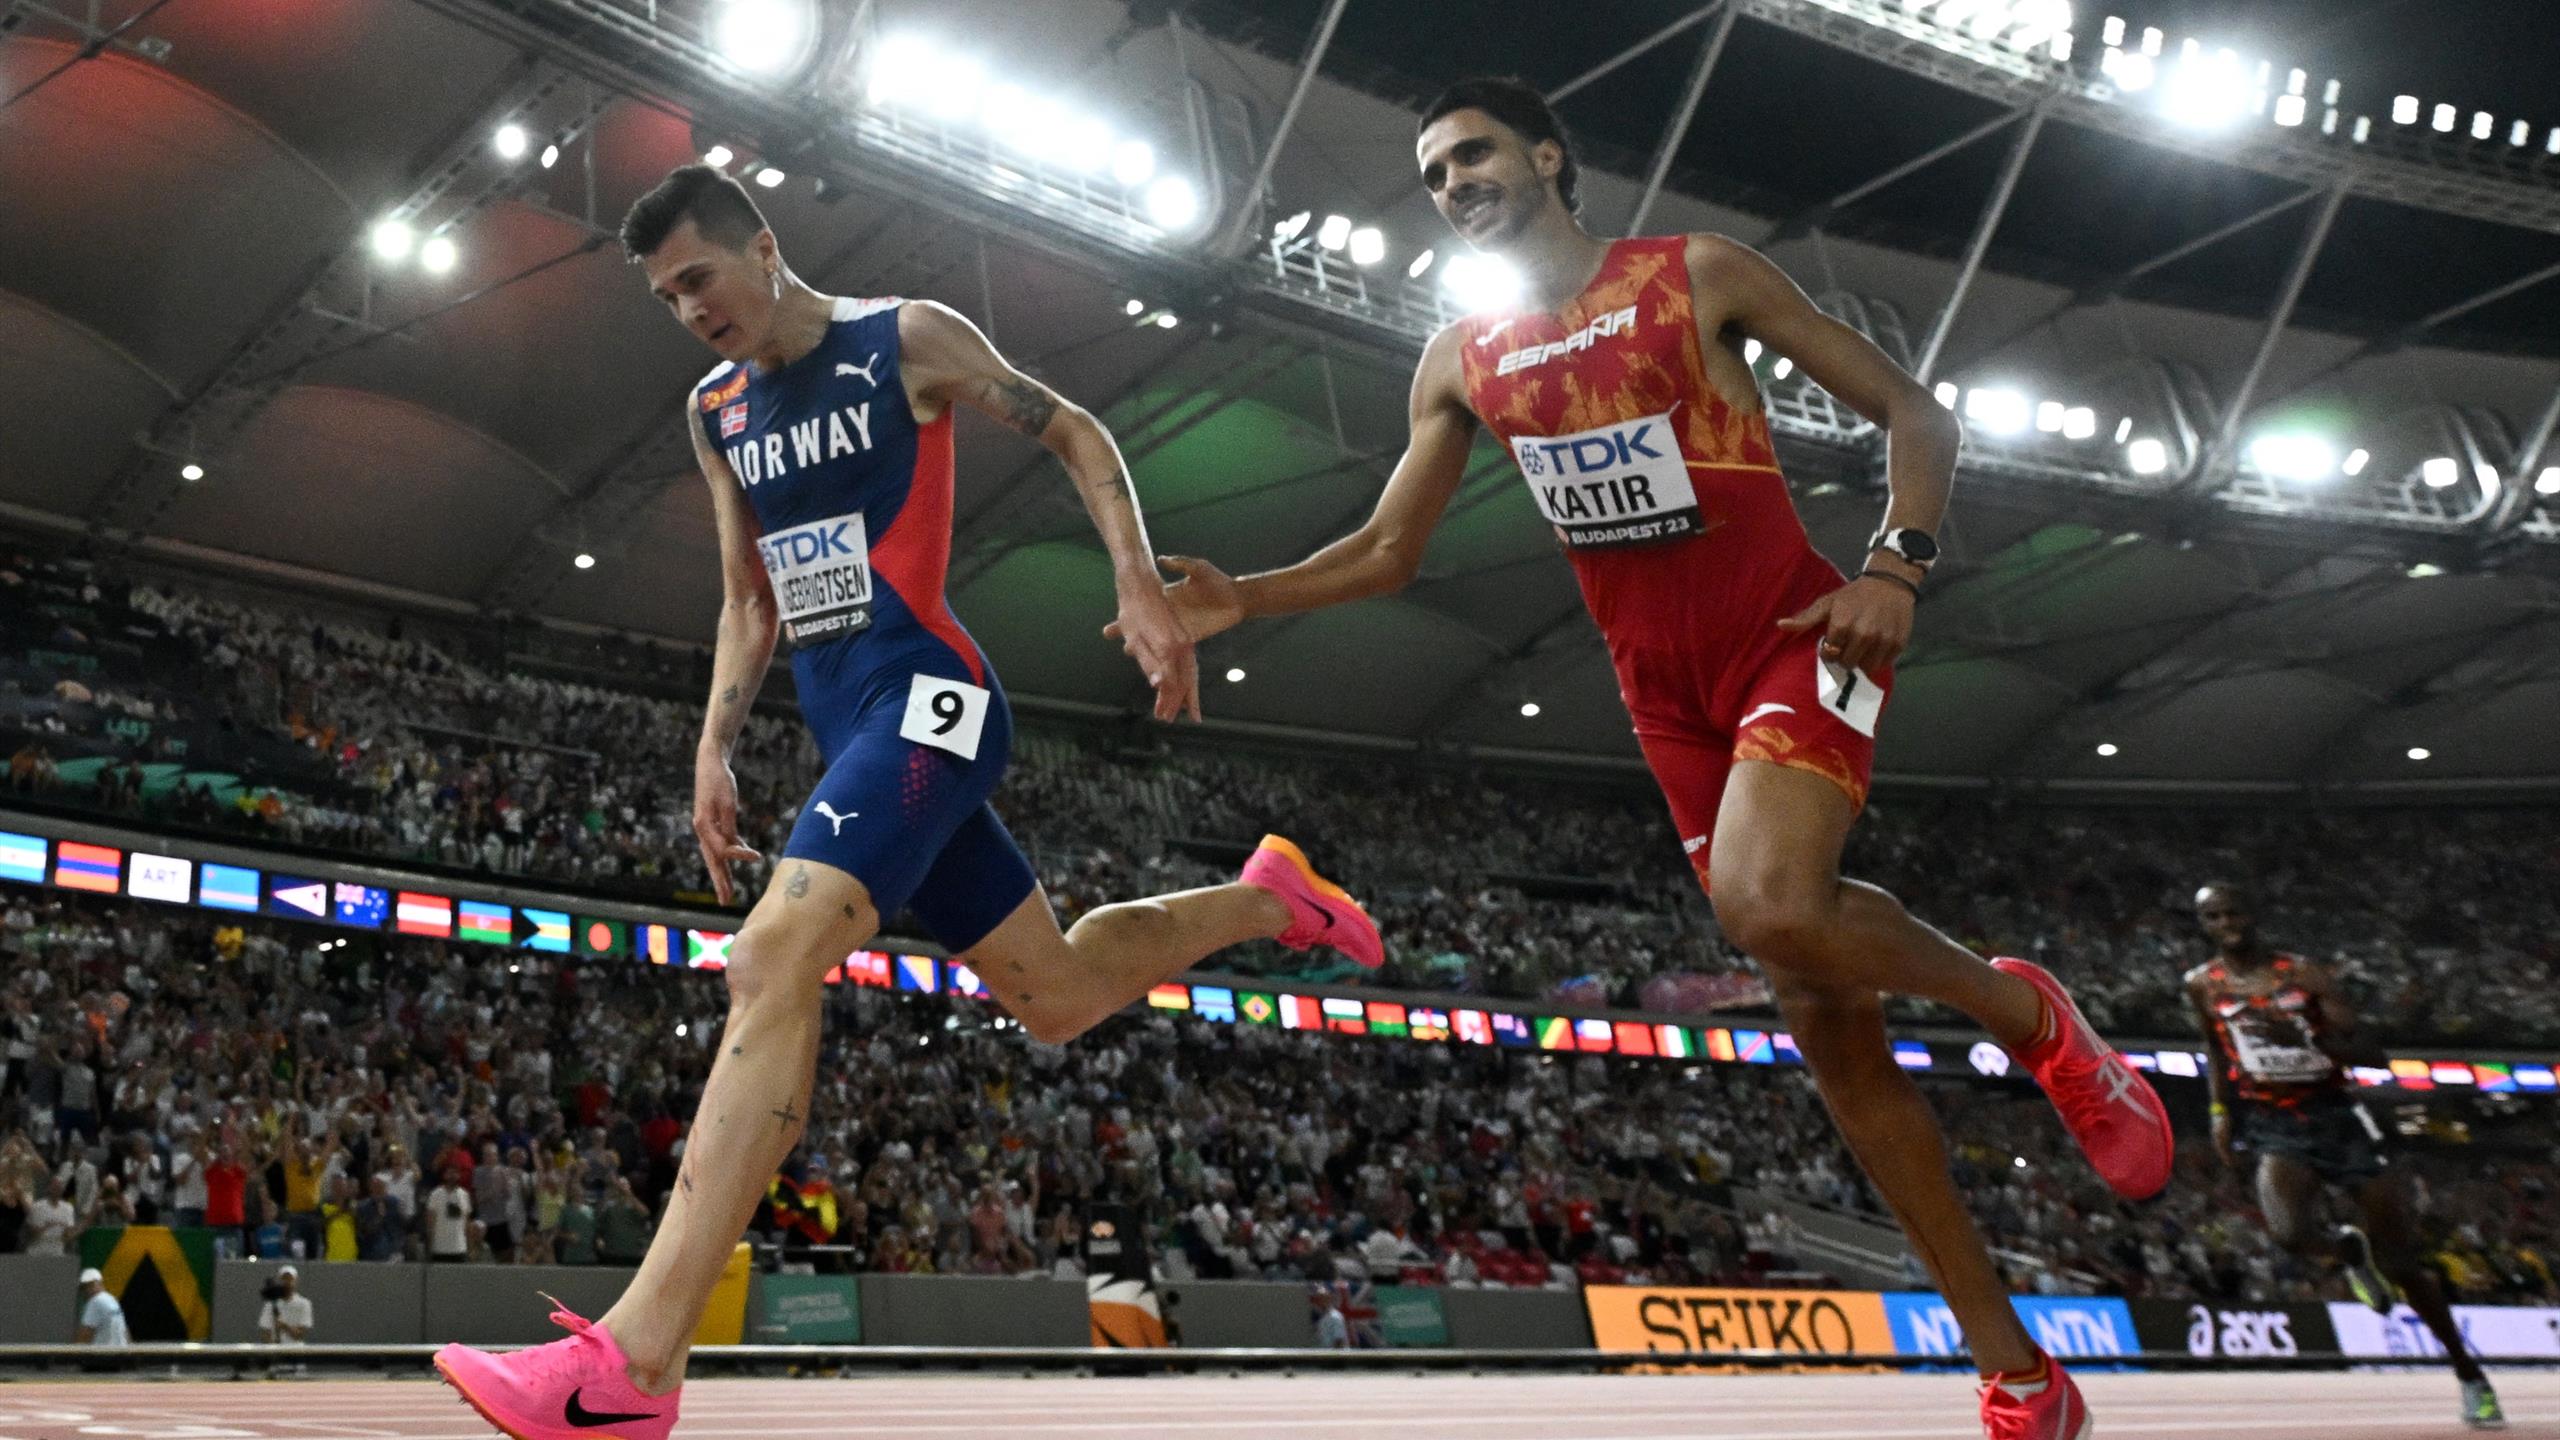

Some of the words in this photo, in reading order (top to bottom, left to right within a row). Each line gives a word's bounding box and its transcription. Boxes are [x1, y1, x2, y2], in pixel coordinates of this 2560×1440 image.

[726, 402, 873, 490] NORWAY
[1539, 423, 1664, 476] TDK
[1542, 474, 1657, 520] KATIR
[771, 521, 853, 569] TDK
[1571, 522, 1662, 545] BUDAPEST
[1665, 516, 1691, 535] 23
[931, 690, 965, 736] 9
[143, 867, 178, 885] ART
[1639, 1296, 1854, 1354] SEIKO
[2033, 1309, 2121, 1357] NTN
[2218, 1311, 2298, 1357] asics
